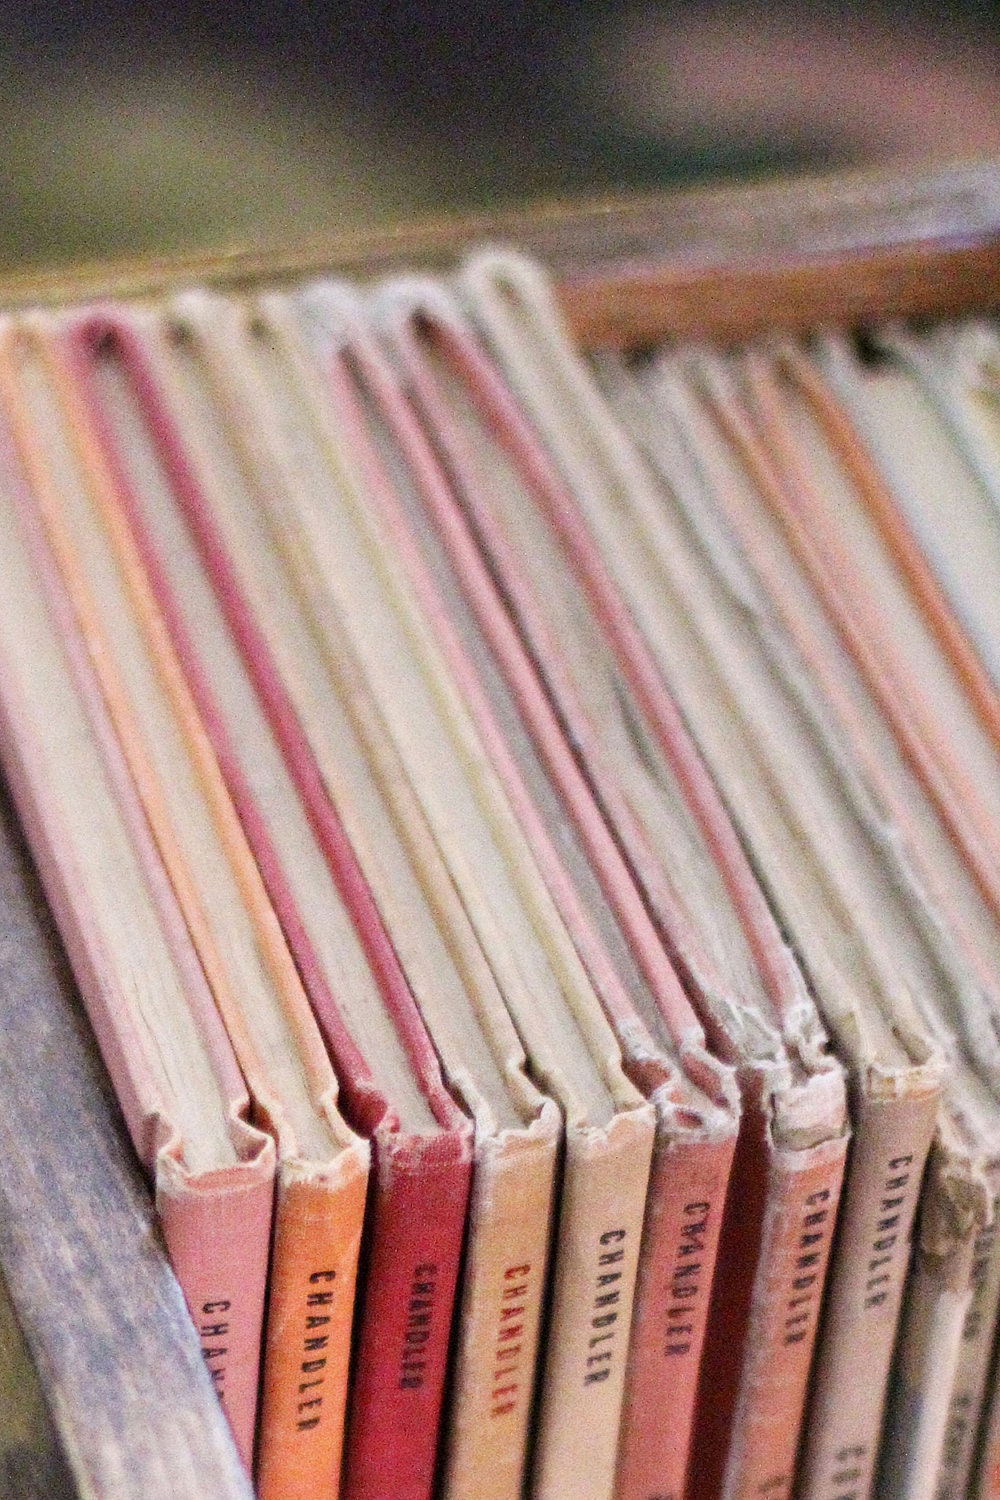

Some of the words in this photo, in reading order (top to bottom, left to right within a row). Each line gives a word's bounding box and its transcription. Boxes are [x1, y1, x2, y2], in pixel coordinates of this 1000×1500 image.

[584, 1229, 626, 1386] CHANDLER
[664, 1202, 710, 1357] CHANDLER
[785, 1190, 830, 1345] CHANDLER
[864, 1154, 913, 1310] CHANDLER
[297, 1270, 336, 1431] CHANDLER
[400, 1264, 437, 1389] CHANDLER
[490, 1264, 531, 1418] CHANDLER
